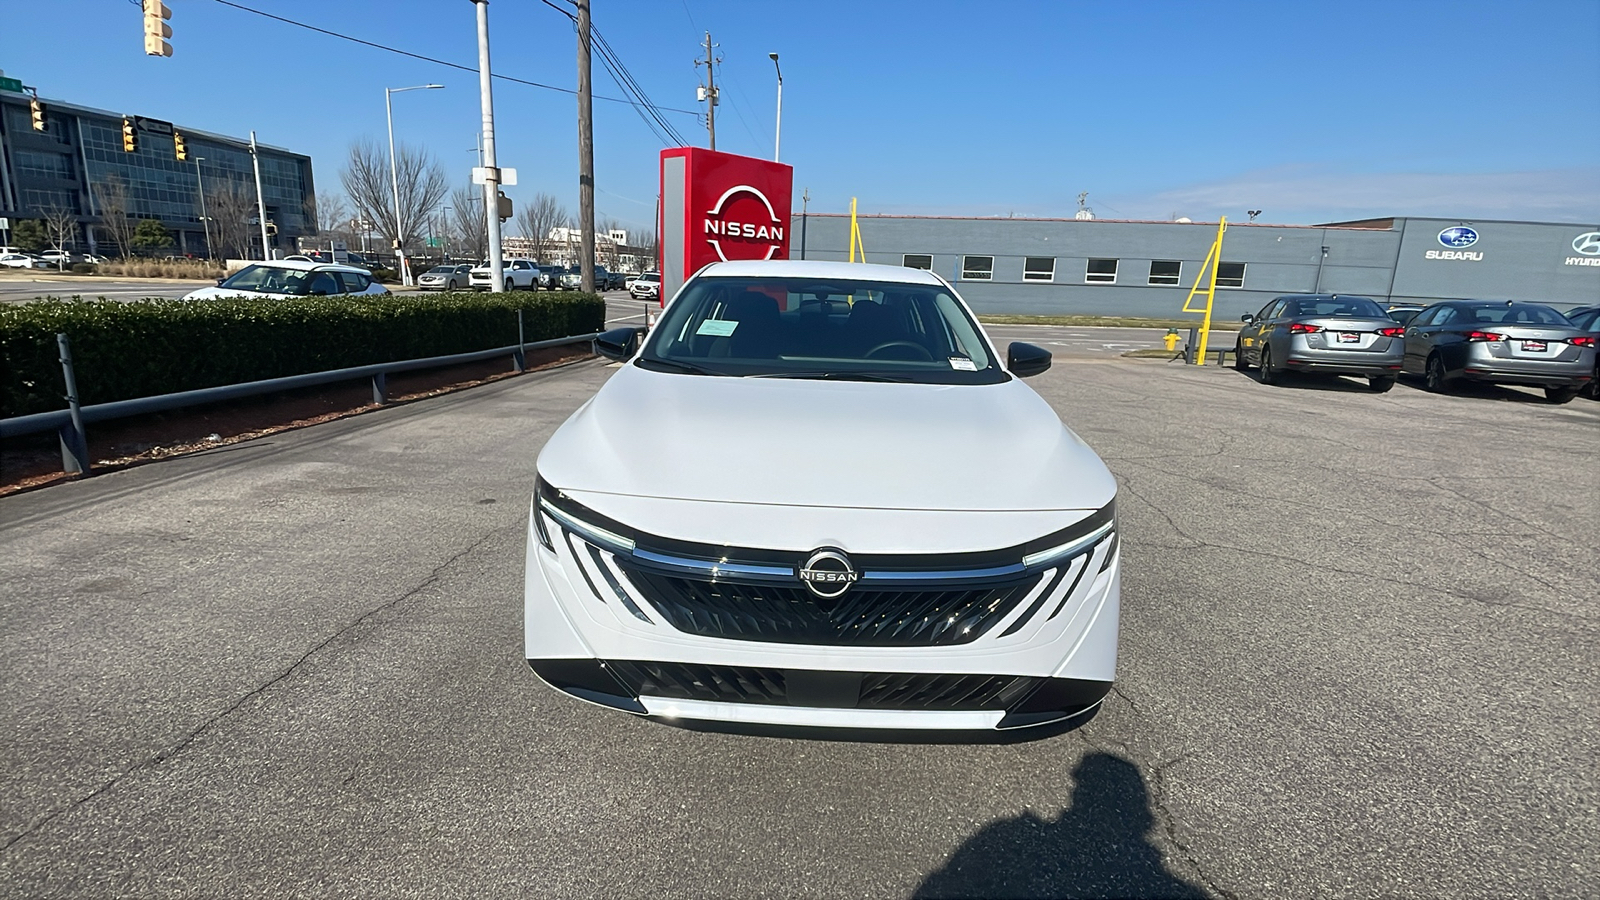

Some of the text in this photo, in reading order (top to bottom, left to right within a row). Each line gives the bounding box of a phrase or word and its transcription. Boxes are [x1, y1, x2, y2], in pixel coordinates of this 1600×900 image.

[704, 218, 784, 241] NISSAN
[1425, 250, 1484, 261] SUBARU
[800, 571, 858, 582] NISSAN
